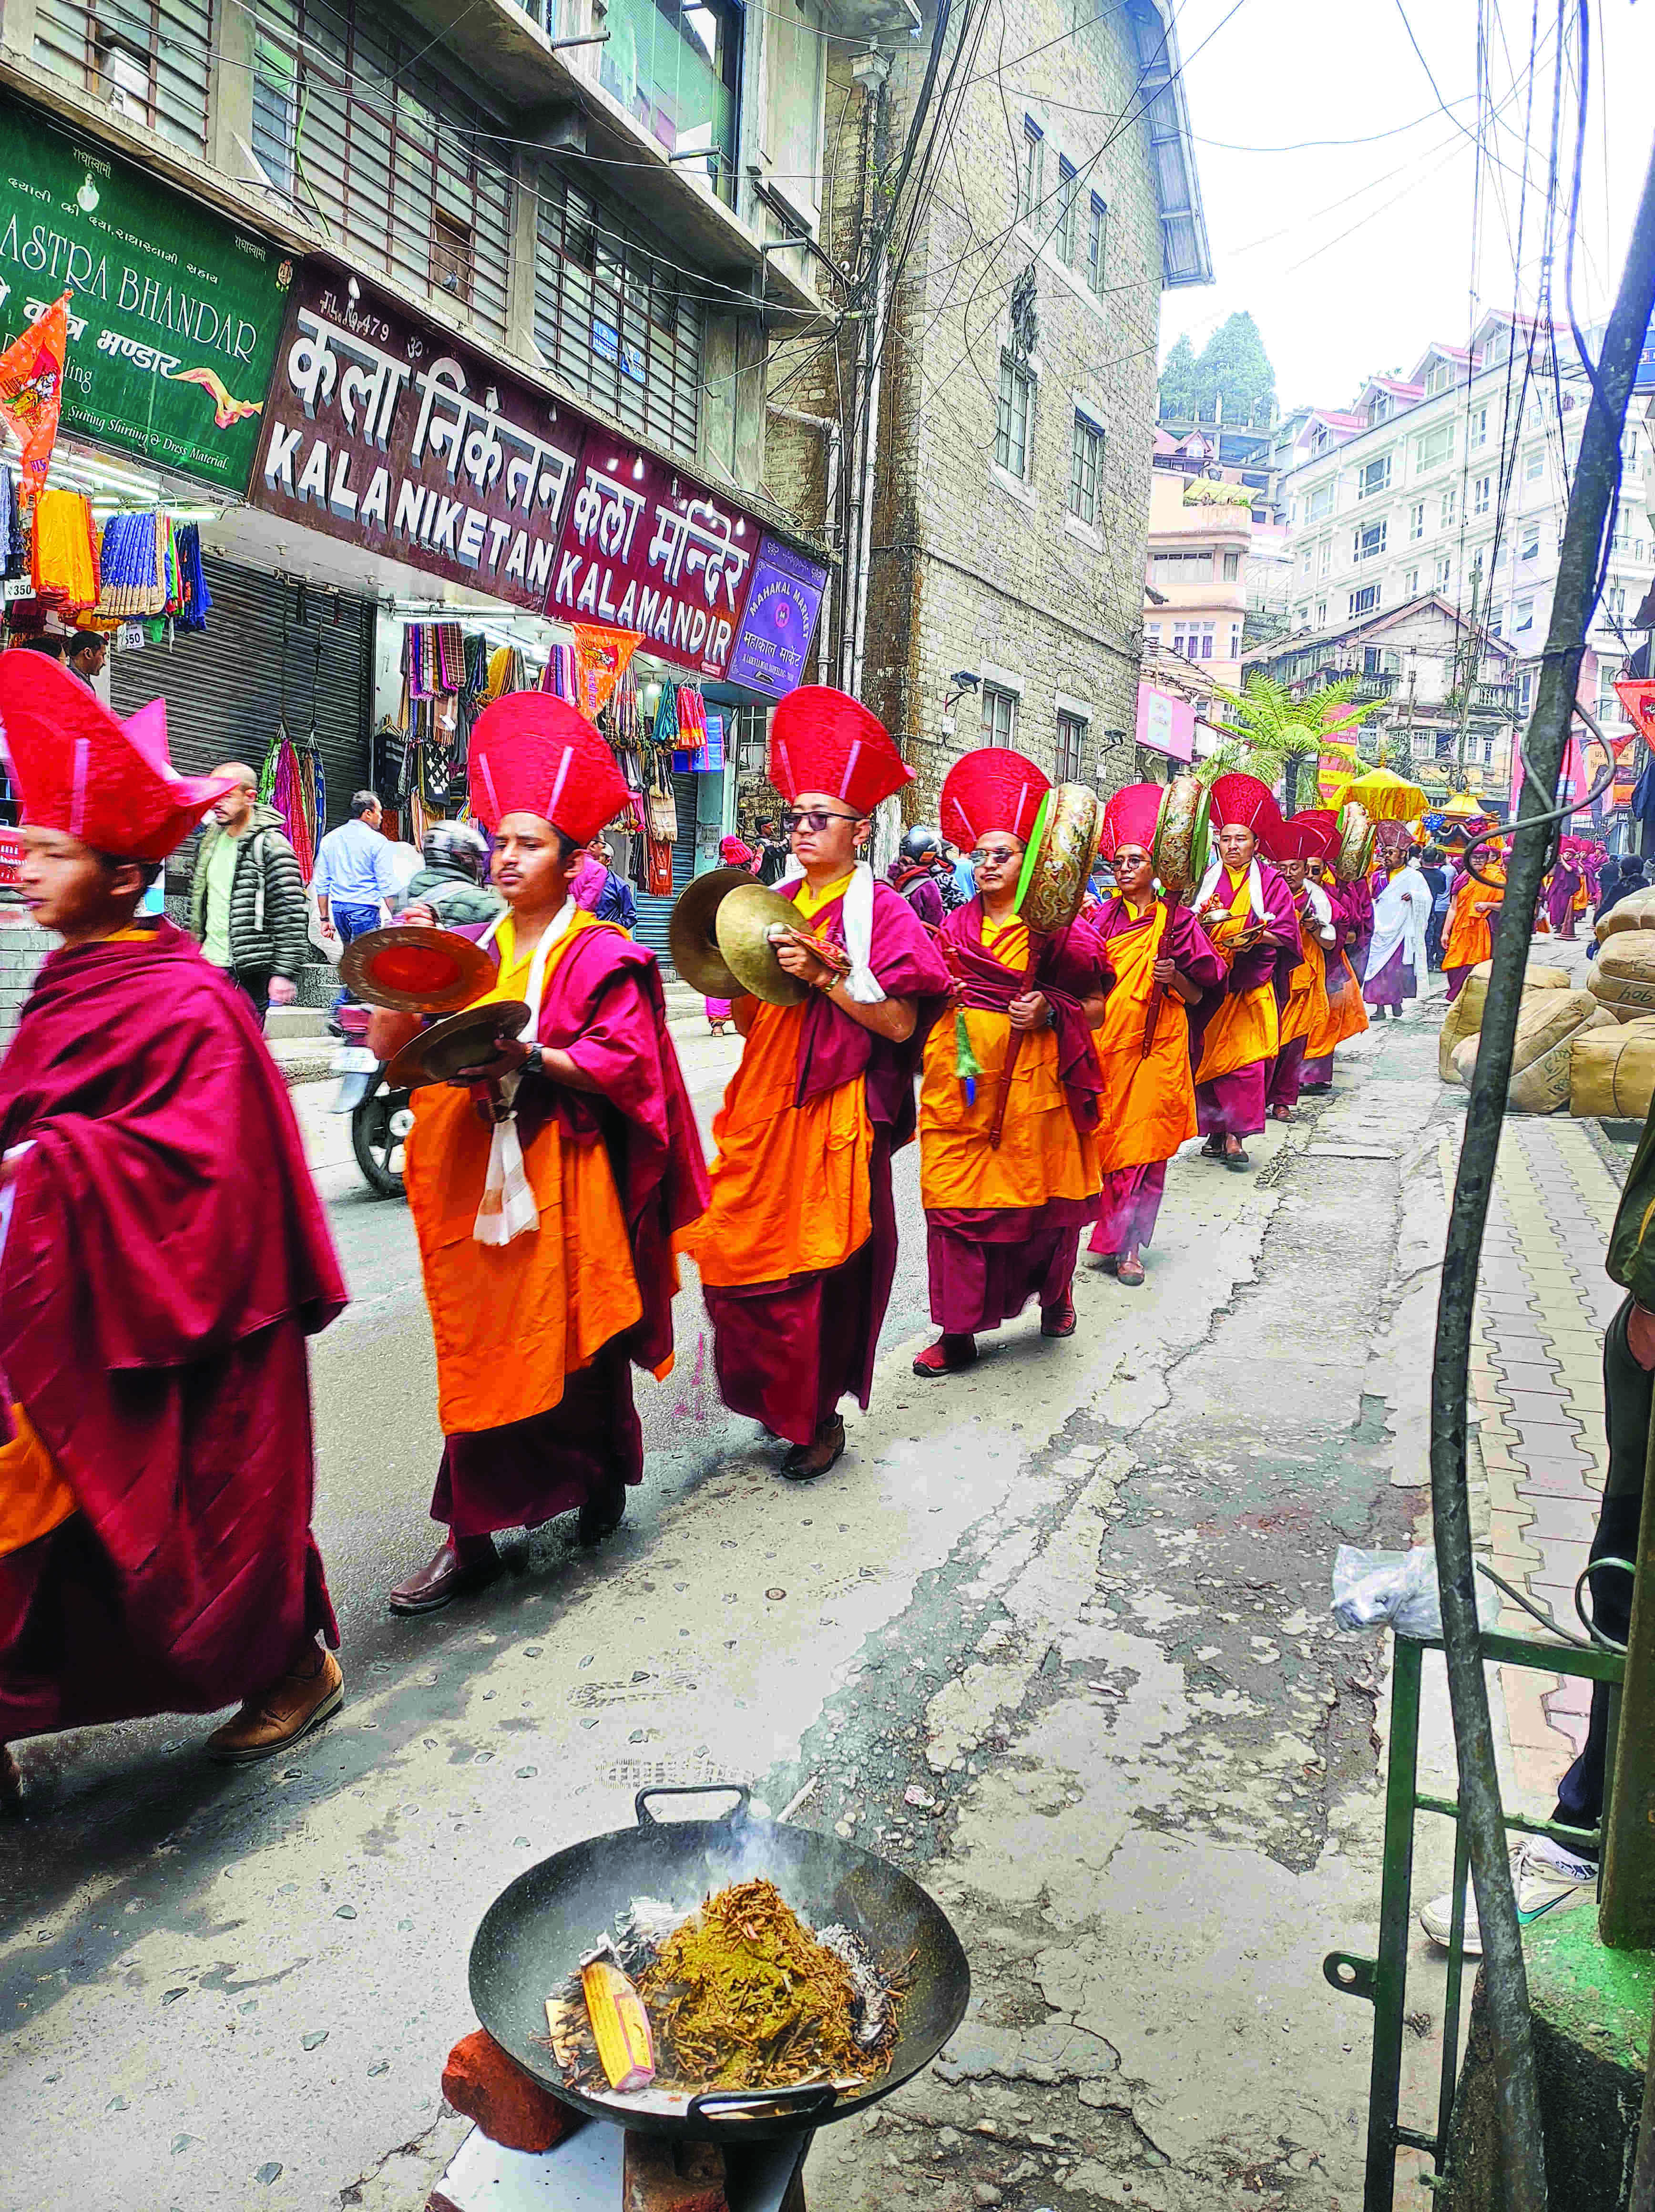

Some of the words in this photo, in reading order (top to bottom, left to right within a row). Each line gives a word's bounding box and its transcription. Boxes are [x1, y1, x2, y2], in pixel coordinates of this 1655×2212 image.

[116, 266, 256, 364] BHANDAR
[97, 329, 183, 379] भण्डार
[70, 406, 105, 432] Suiting
[163, 438, 188, 455] Dress
[288, 306, 412, 451] कला
[411, 357, 577, 530] निकेतन
[573, 466, 647, 563] कला
[749, 581, 790, 618] MAHAKAL
[793, 589, 809, 639] MARKET
[743, 631, 778, 658] महाकाल
